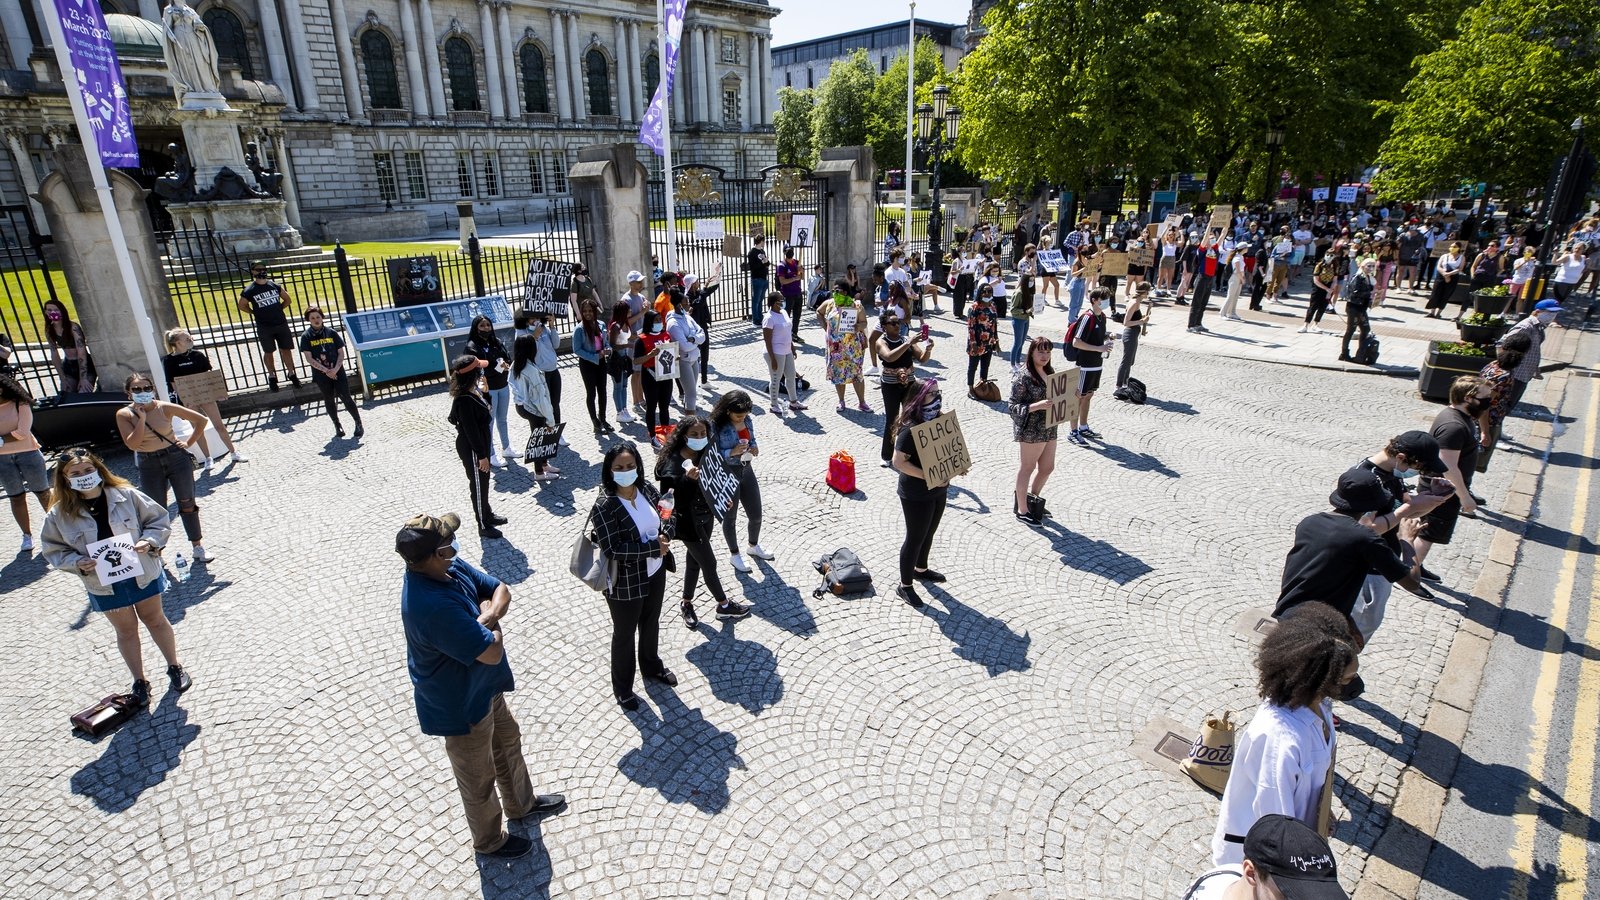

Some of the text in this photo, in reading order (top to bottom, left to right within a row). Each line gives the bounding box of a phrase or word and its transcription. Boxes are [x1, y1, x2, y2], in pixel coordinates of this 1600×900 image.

[68, 7, 80, 20] 23
[62, 17, 112, 41] March 2020
[530, 259, 573, 277] NO LIVES
[527, 272, 568, 290] MATTER TIL
[253, 289, 279, 301] PUBLIC
[257, 297, 281, 308] ENEMY
[525, 286, 553, 301] BLACK
[523, 299, 569, 315] LIVES MATTER
[1051, 374, 1067, 398] NO
[1051, 400, 1067, 424] NO
[918, 415, 960, 449] BLACK
[525, 442, 557, 459] PANDEMIC
[527, 435, 544, 448] IS A
[933, 436, 963, 461] LIVES
[699, 442, 724, 491] BLACK
[928, 452, 970, 484] MATTER.
[708, 466, 728, 500] LIVES
[714, 472, 740, 520] MATTER
[91, 542, 135, 560] BLACK LIVES
[108, 565, 133, 577] MATTER
